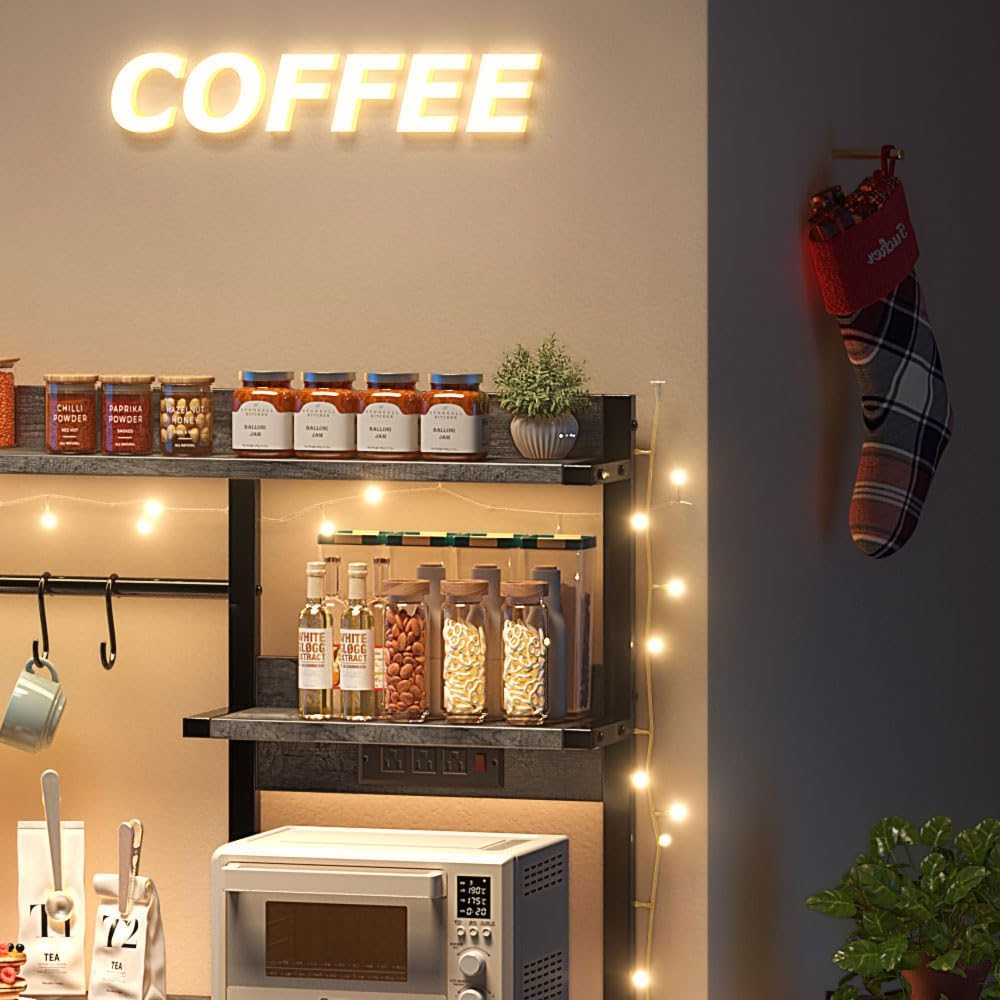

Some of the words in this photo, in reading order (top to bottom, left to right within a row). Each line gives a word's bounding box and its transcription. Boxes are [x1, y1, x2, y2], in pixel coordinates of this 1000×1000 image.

[110, 52, 543, 133] COFFEE
[56, 404, 83, 412] CHILLI
[109, 404, 143, 413] PAPRIKA
[53, 414, 88, 423] POWDER
[108, 415, 143, 423] POWDER
[102, 914, 139, 949] 72
[44, 953, 60, 962] TEA
[111, 961, 123, 971] TEA
